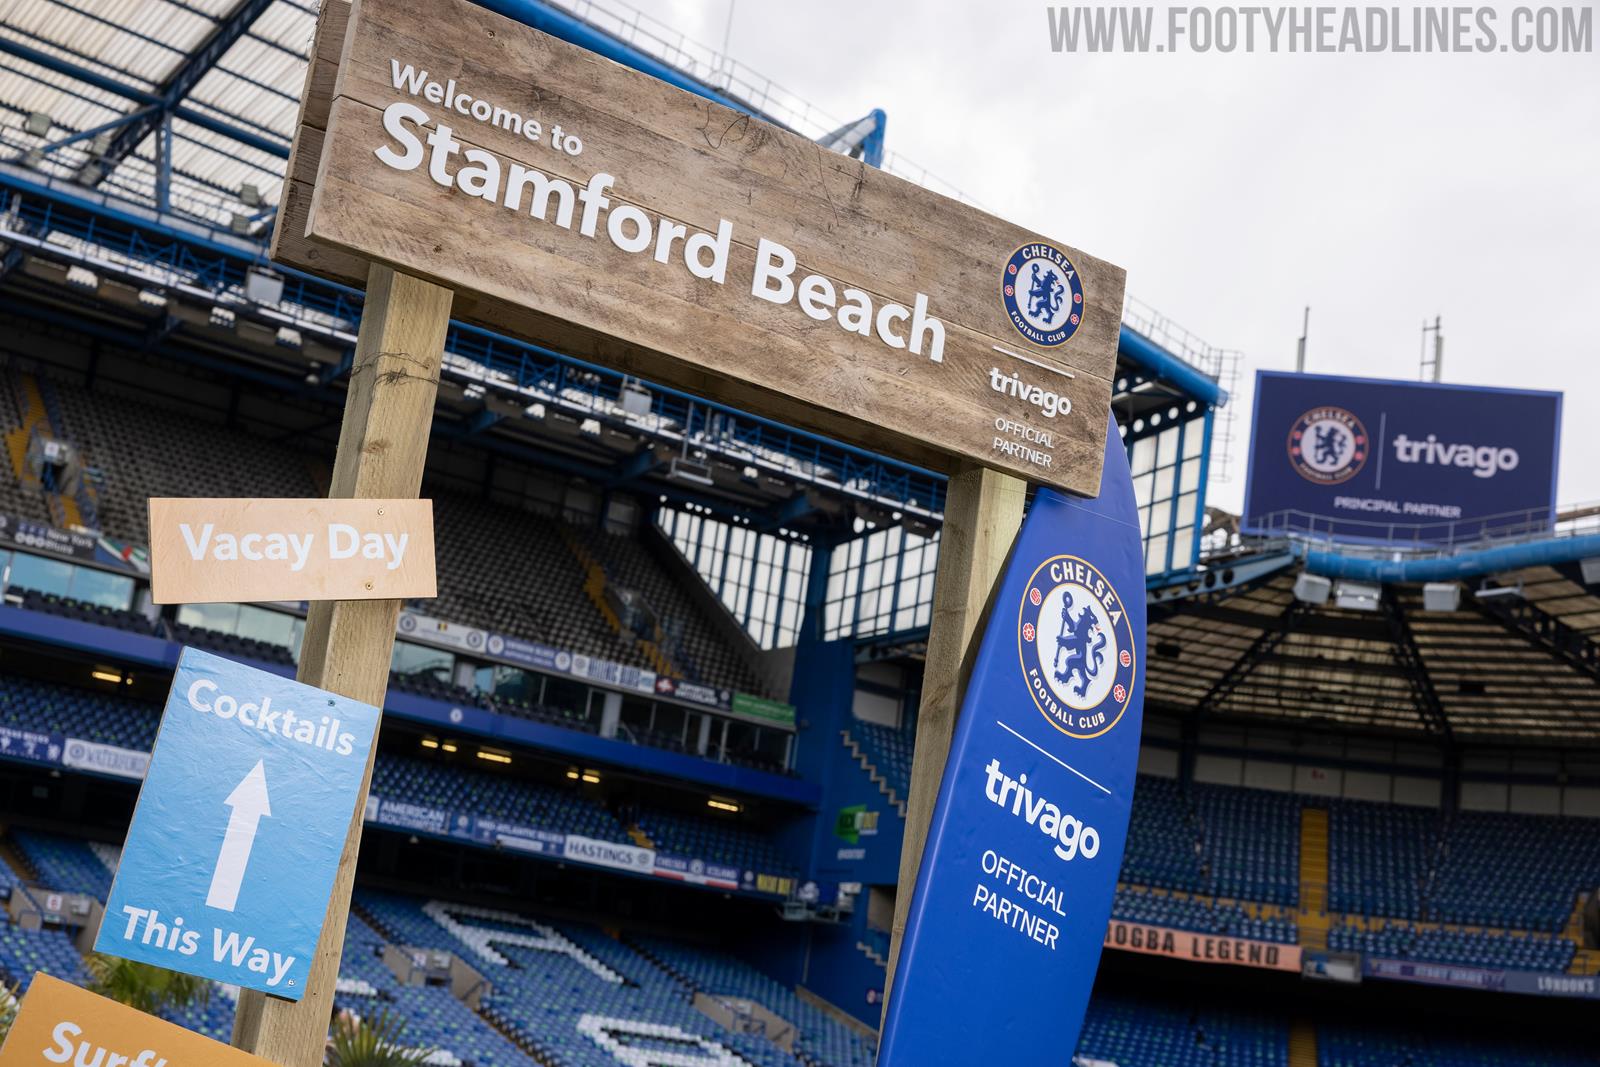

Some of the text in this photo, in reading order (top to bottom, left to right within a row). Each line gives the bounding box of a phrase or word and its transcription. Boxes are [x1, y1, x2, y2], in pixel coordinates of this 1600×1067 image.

[389, 58, 584, 156] Welcome to
[373, 101, 946, 364] Stamford Beach
[1022, 245, 1076, 281] CHELSEA
[1011, 310, 1067, 343] FOOTBALL CLUB
[989, 366, 1072, 419] trivago
[992, 436, 1053, 468] PARTNER
[994, 417, 1055, 449] OFFICIAL
[1392, 433, 1519, 479] trivago
[1333, 495, 1462, 519] PRINCIPAL PARTNER
[179, 523, 409, 572] Vacay Day
[1050, 561, 1123, 627] CHELSEA
[187, 678, 356, 757] Cocktails
[1029, 668, 1106, 729] FOOTBALL CLUB
[984, 758, 1101, 862] trivago
[568, 840, 634, 865] HASTINGS
[981, 849, 1067, 917] OFFICIAL
[973, 883, 1060, 951] PARTNER
[122, 904, 296, 987] This Way
[1191, 936, 1281, 966] LEGEND
